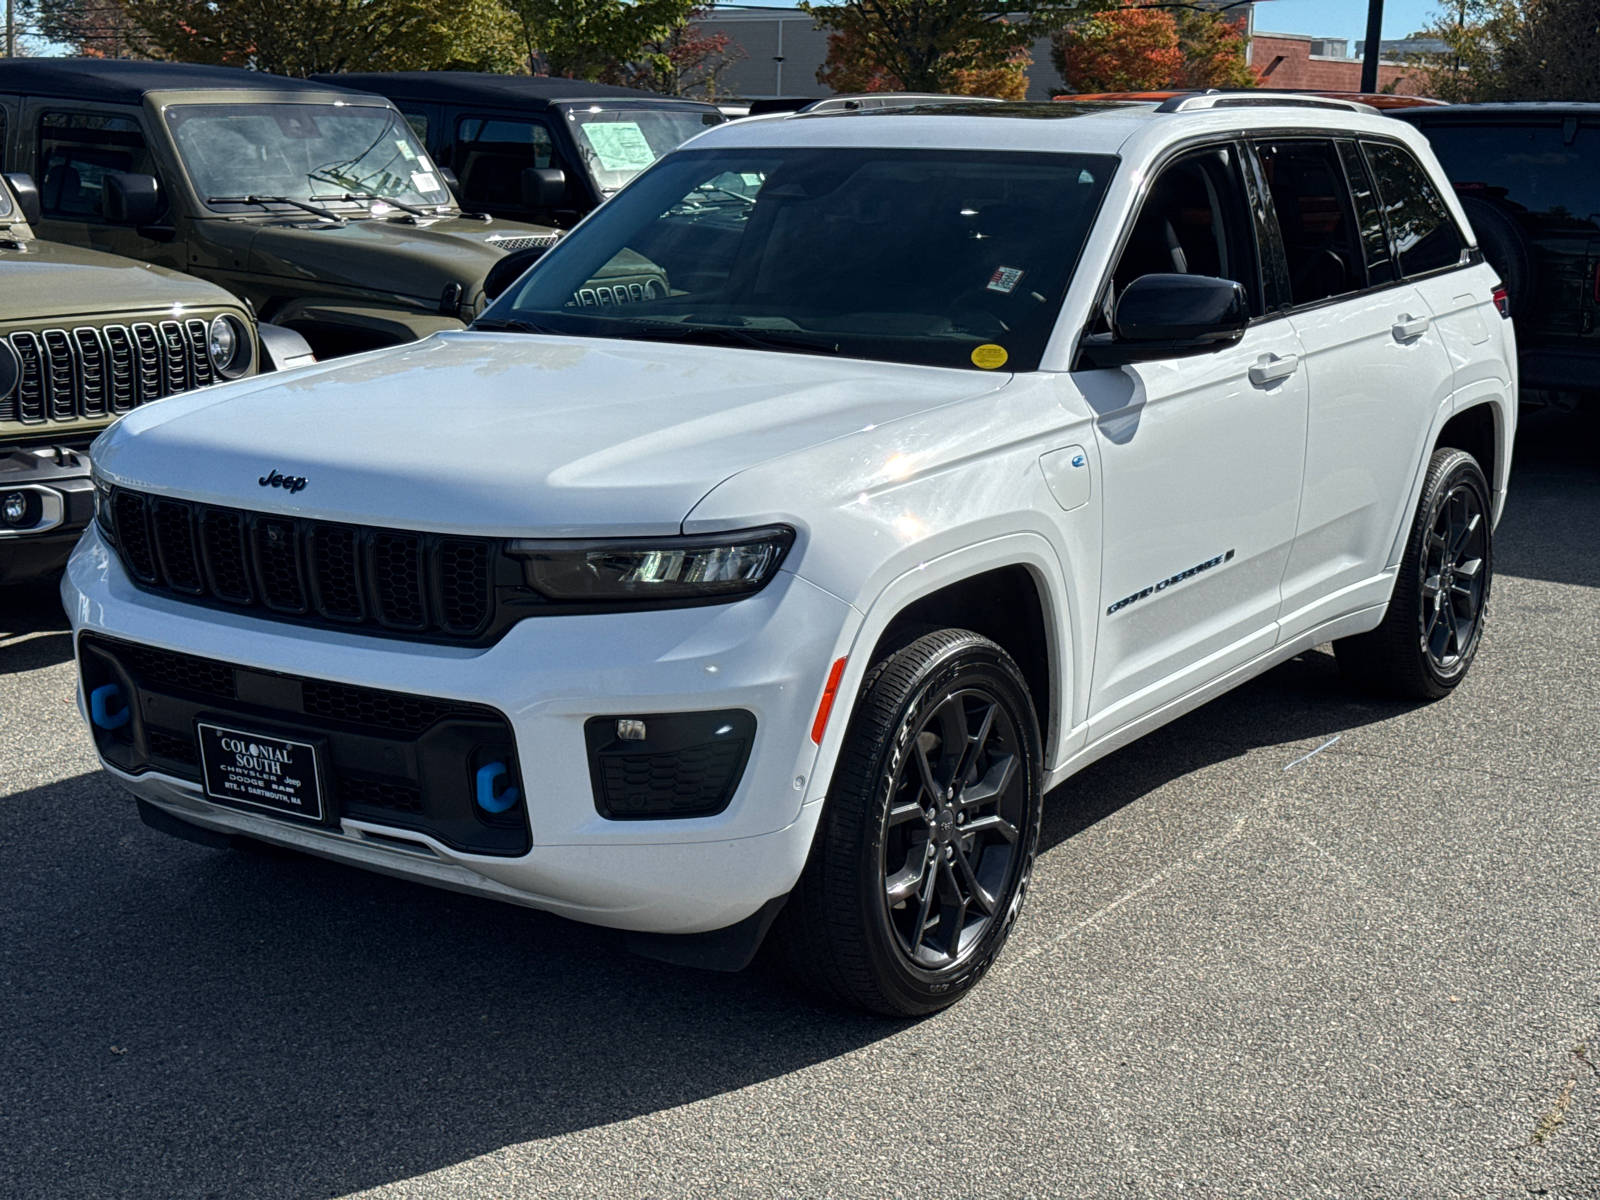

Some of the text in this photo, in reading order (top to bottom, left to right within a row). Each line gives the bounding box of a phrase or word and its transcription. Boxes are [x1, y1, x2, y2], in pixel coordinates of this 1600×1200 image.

[258, 468, 309, 494] Jeep
[221, 737, 293, 764] COLONIAL
[220, 764, 302, 788] CHRYSLER Jeep
[235, 753, 282, 775] SOUTH
[224, 781, 302, 805] RTE. 6 DARTMOUTH, MA
[229, 773, 295, 794] DODGE RAM
